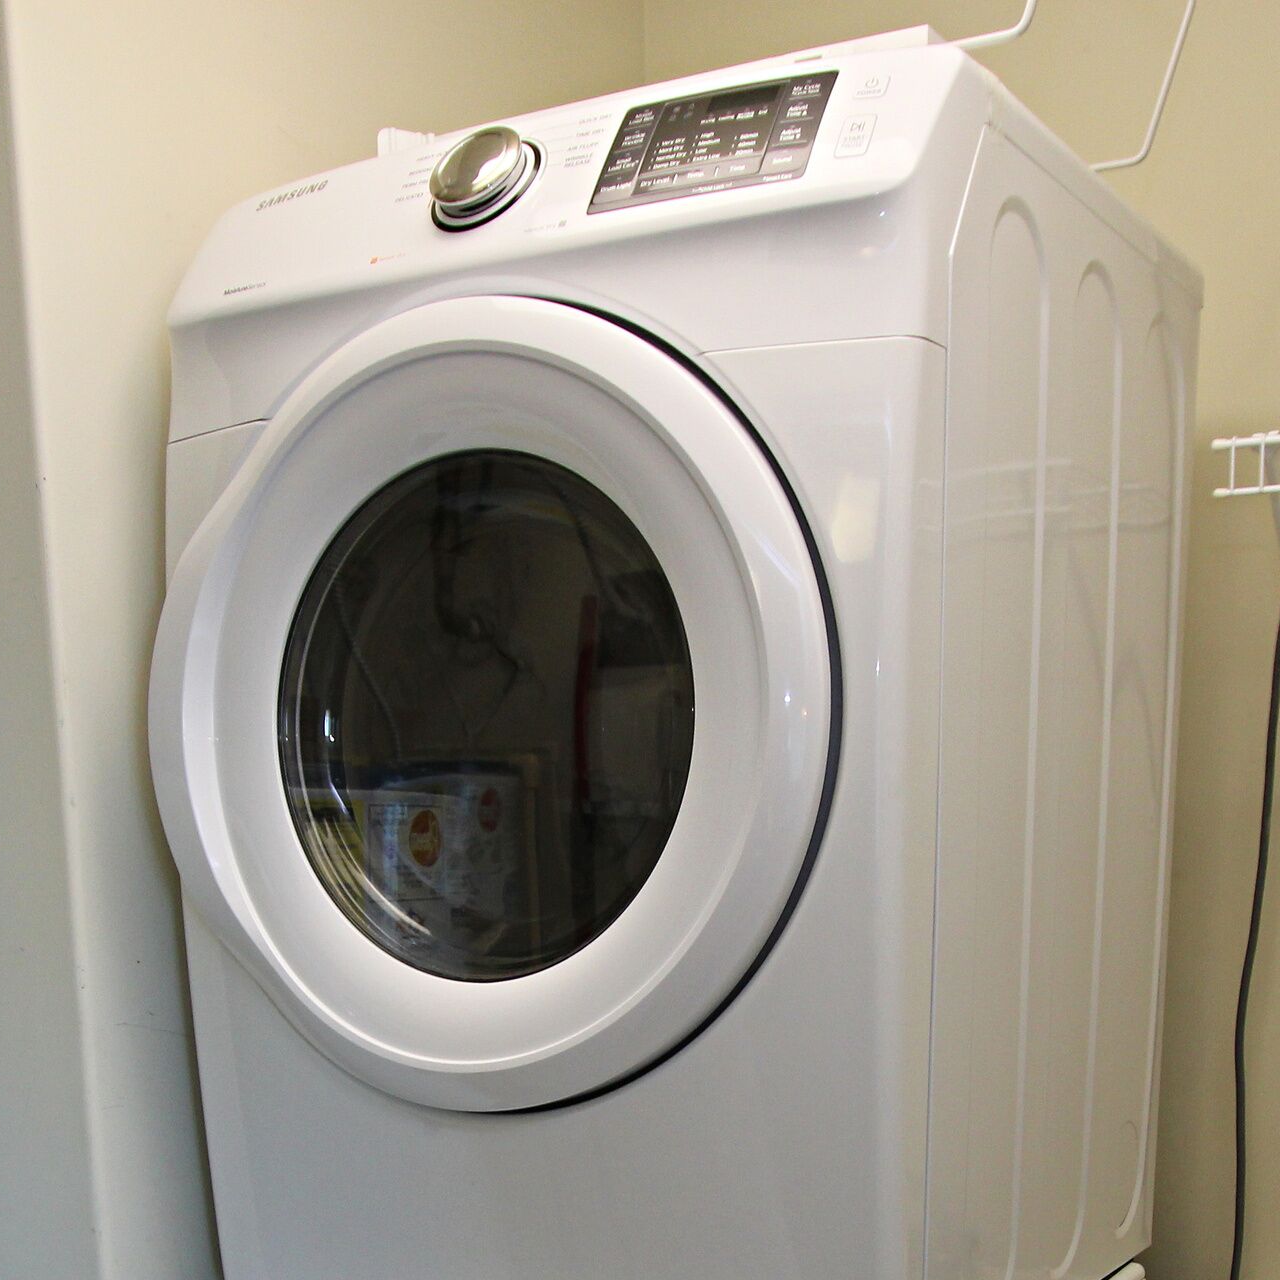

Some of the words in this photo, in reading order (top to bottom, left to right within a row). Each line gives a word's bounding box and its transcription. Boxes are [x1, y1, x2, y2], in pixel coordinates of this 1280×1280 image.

[675, 136, 686, 145] Dry
[674, 144, 684, 152] Dry
[655, 154, 675, 162] Normal
[676, 152, 687, 160] Dry
[670, 160, 681, 168] Dry
[640, 179, 652, 188] Dry
[653, 176, 671, 186] Level
[256, 180, 328, 212] SAMSUNG
